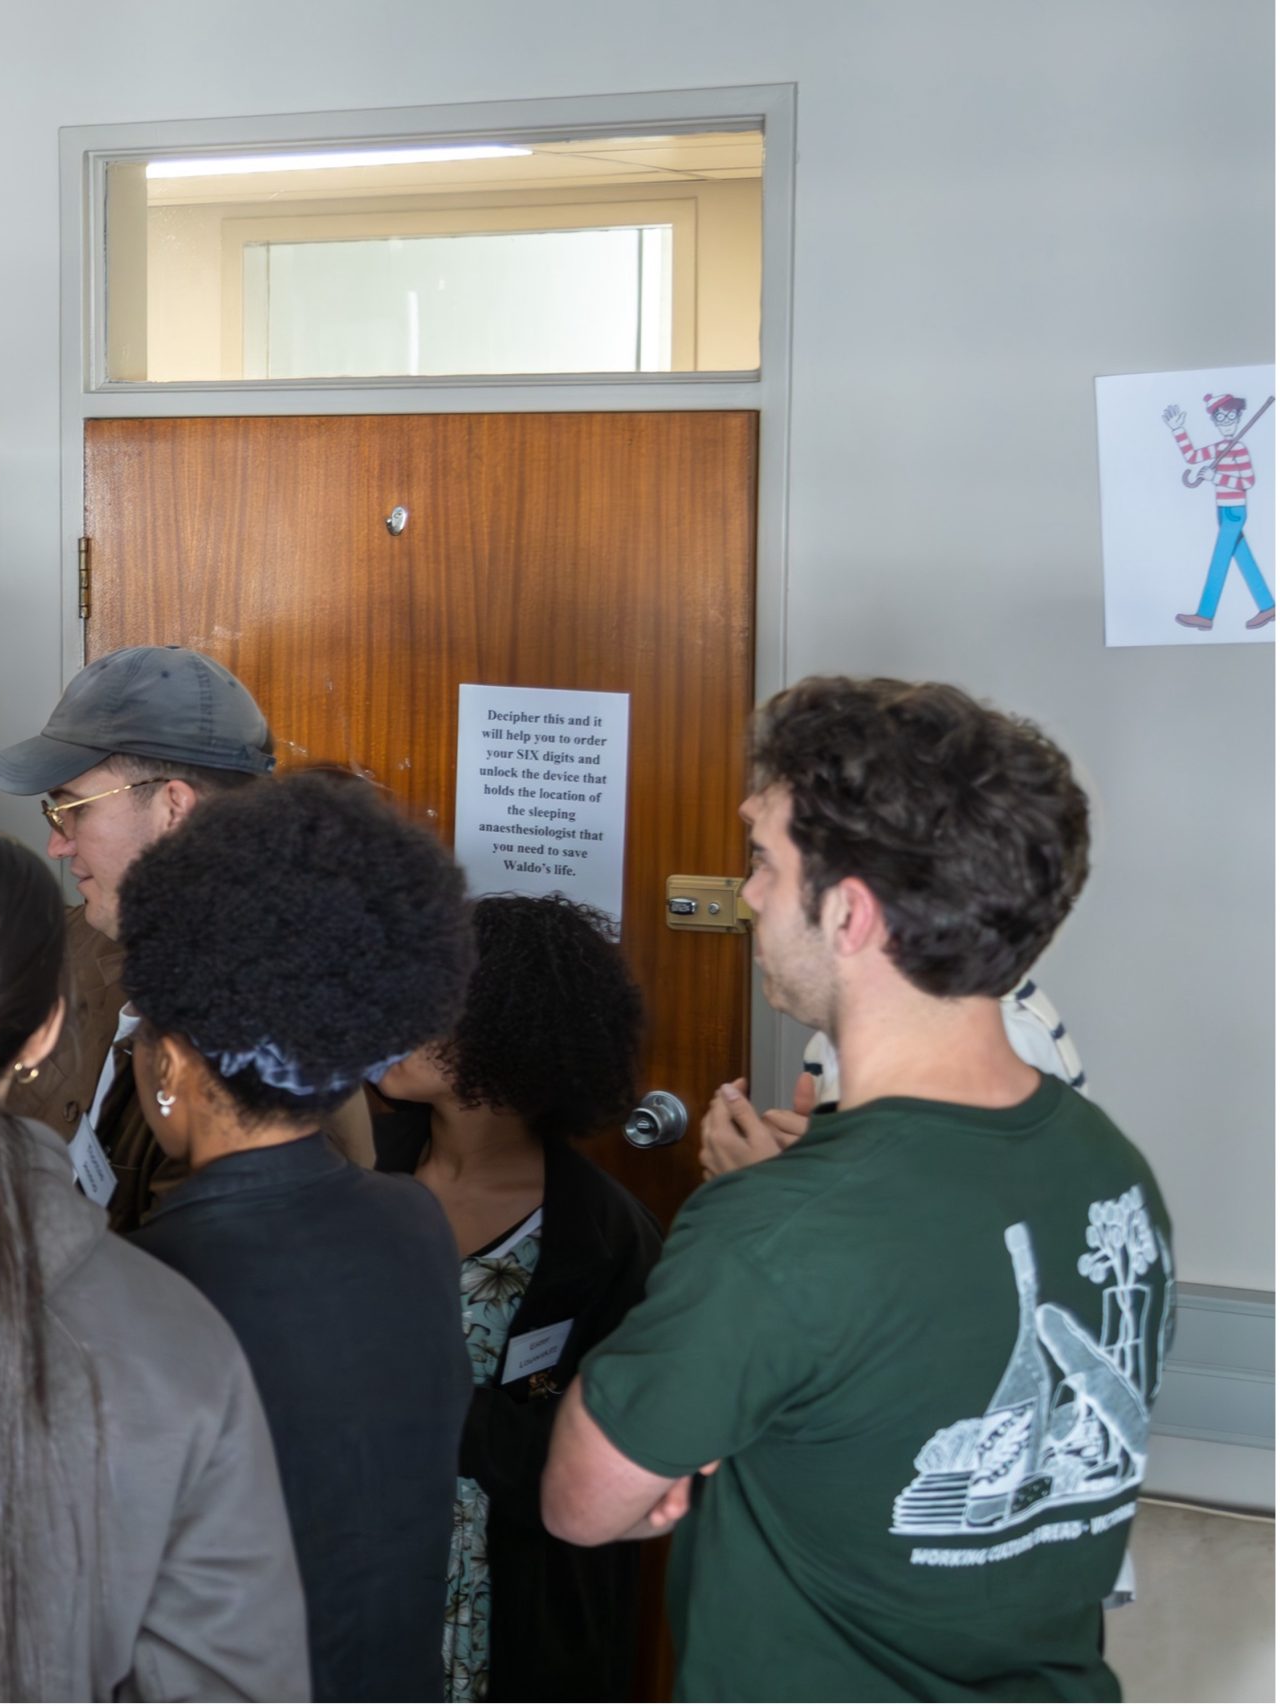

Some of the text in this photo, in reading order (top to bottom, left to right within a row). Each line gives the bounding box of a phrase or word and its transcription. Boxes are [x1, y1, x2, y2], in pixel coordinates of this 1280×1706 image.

[488, 710, 602, 727] Decipher this and it
[482, 729, 607, 747] will help you to order
[486, 749, 600, 765] your SIX digits and
[479, 767, 607, 785] unlock the device that
[484, 784, 602, 803] holds the location of
[507, 805, 576, 821] the sleeping
[479, 823, 603, 841] anaesthesiologist that
[493, 843, 588, 858] you need to save
[504, 860, 576, 876] Waldo's life.
